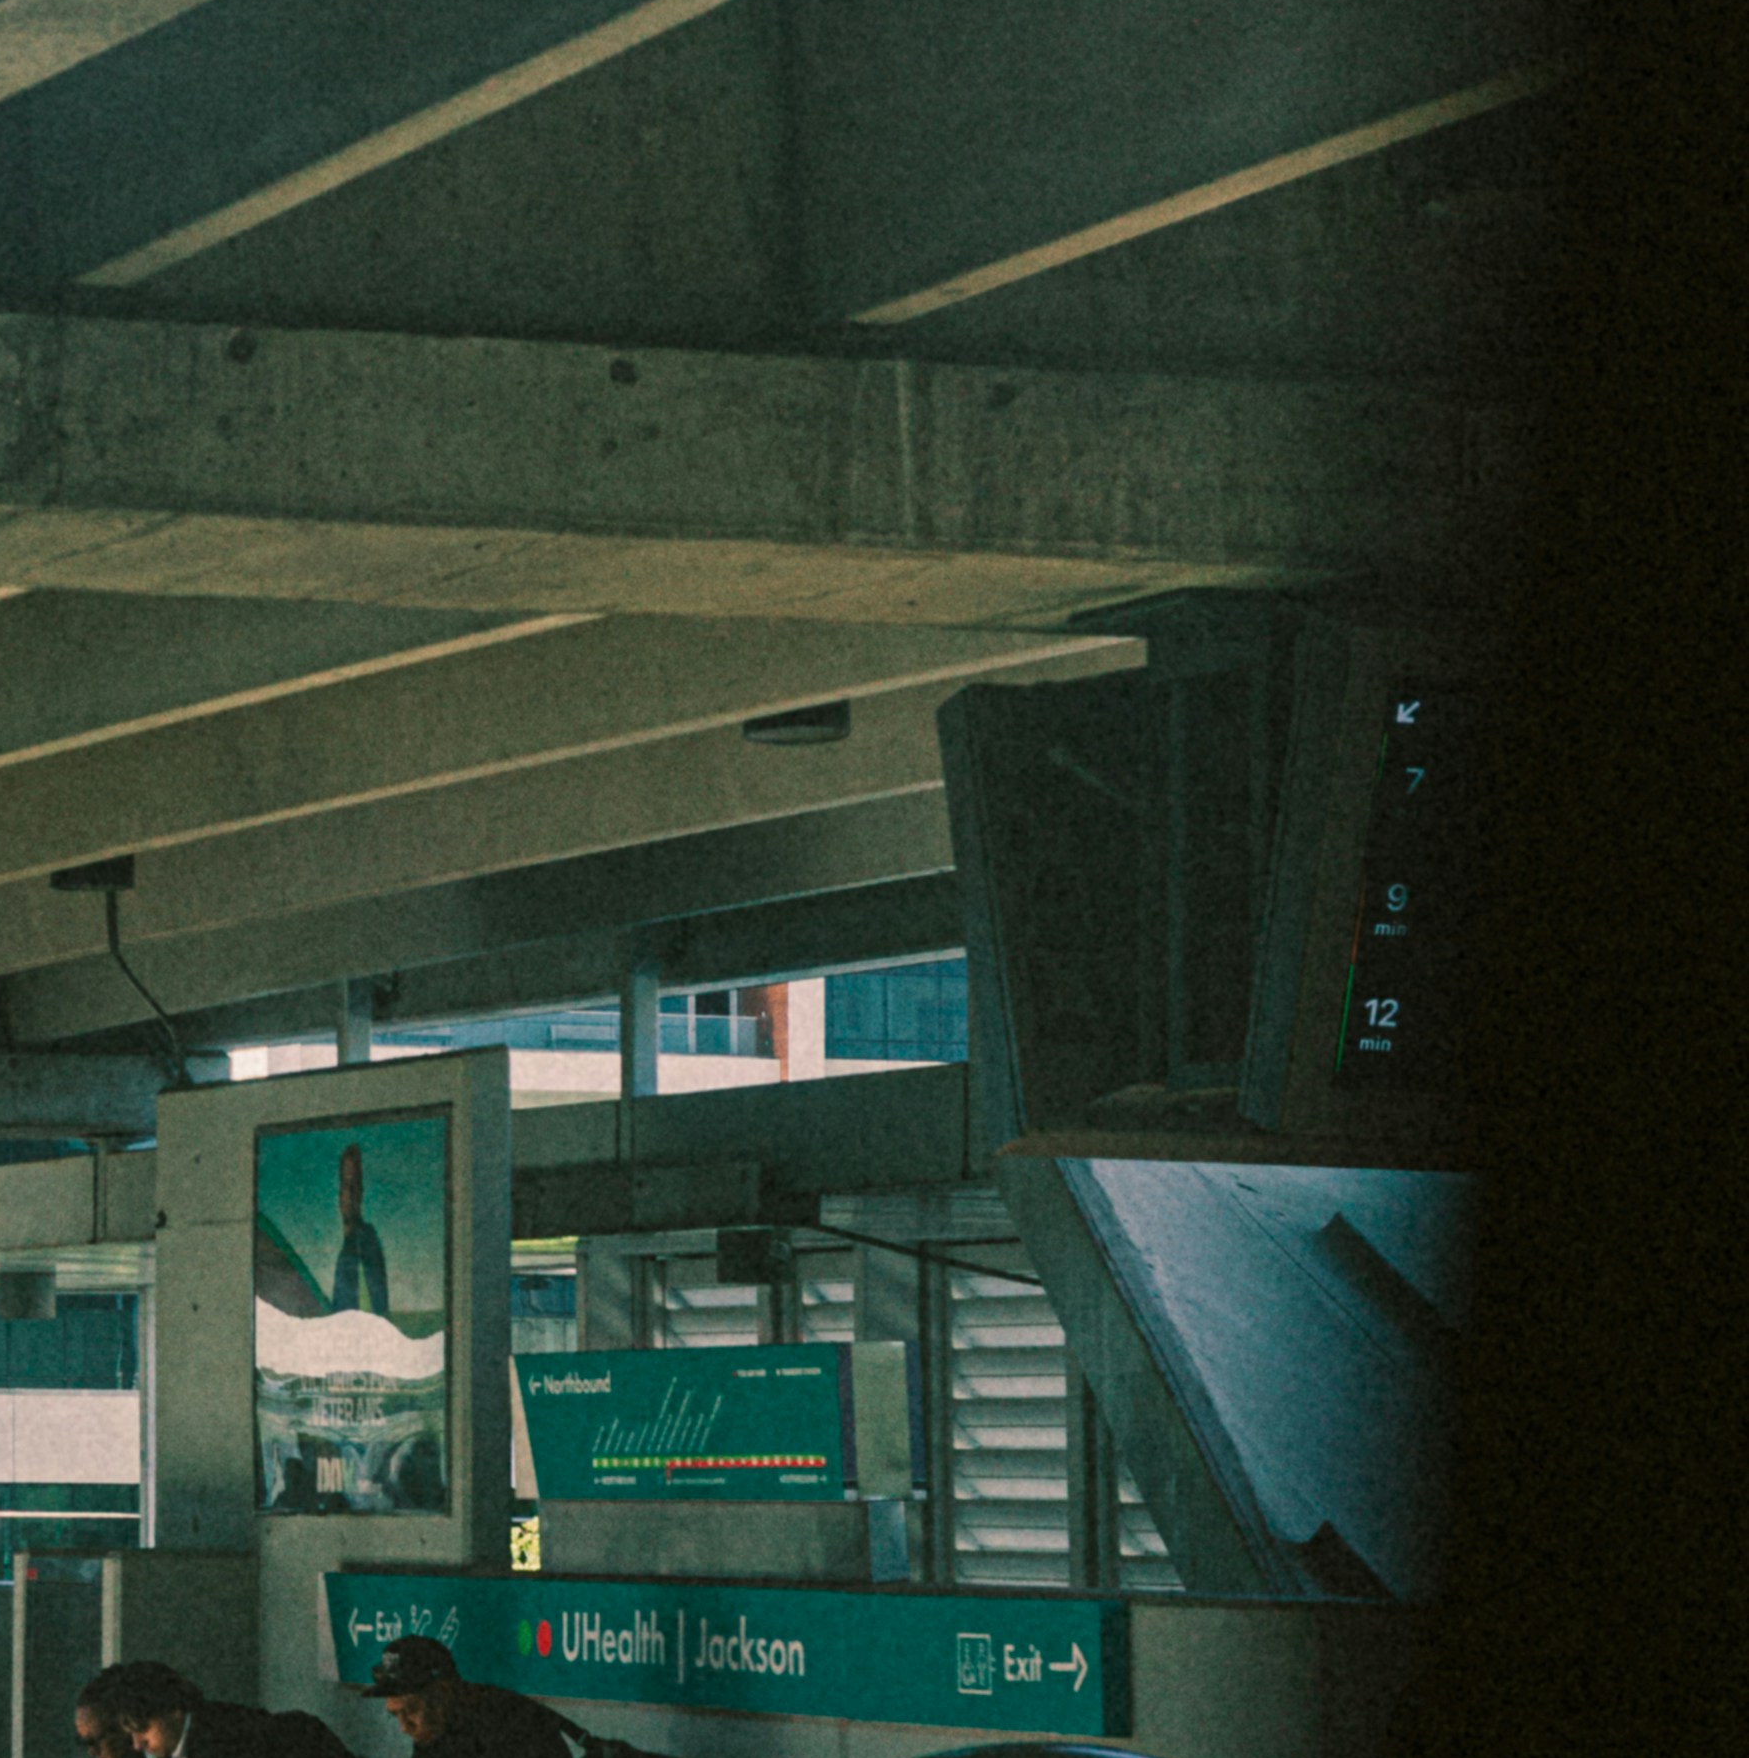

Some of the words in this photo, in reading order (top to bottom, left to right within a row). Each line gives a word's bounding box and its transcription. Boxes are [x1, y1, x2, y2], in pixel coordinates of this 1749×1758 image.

[1405, 767, 1425, 795] 7
[1387, 883, 1408, 912] 9
[1373, 921, 1408, 936] min
[1365, 998, 1399, 1027] 12
[1359, 1035, 1392, 1051] min
[544, 1369, 611, 1395] Northbound
[376, 1610, 402, 1642] Exit
[562, 1609, 665, 1665] UHealth
[695, 1615, 805, 1677] Jackson
[1004, 1644, 1042, 1682] Exit
